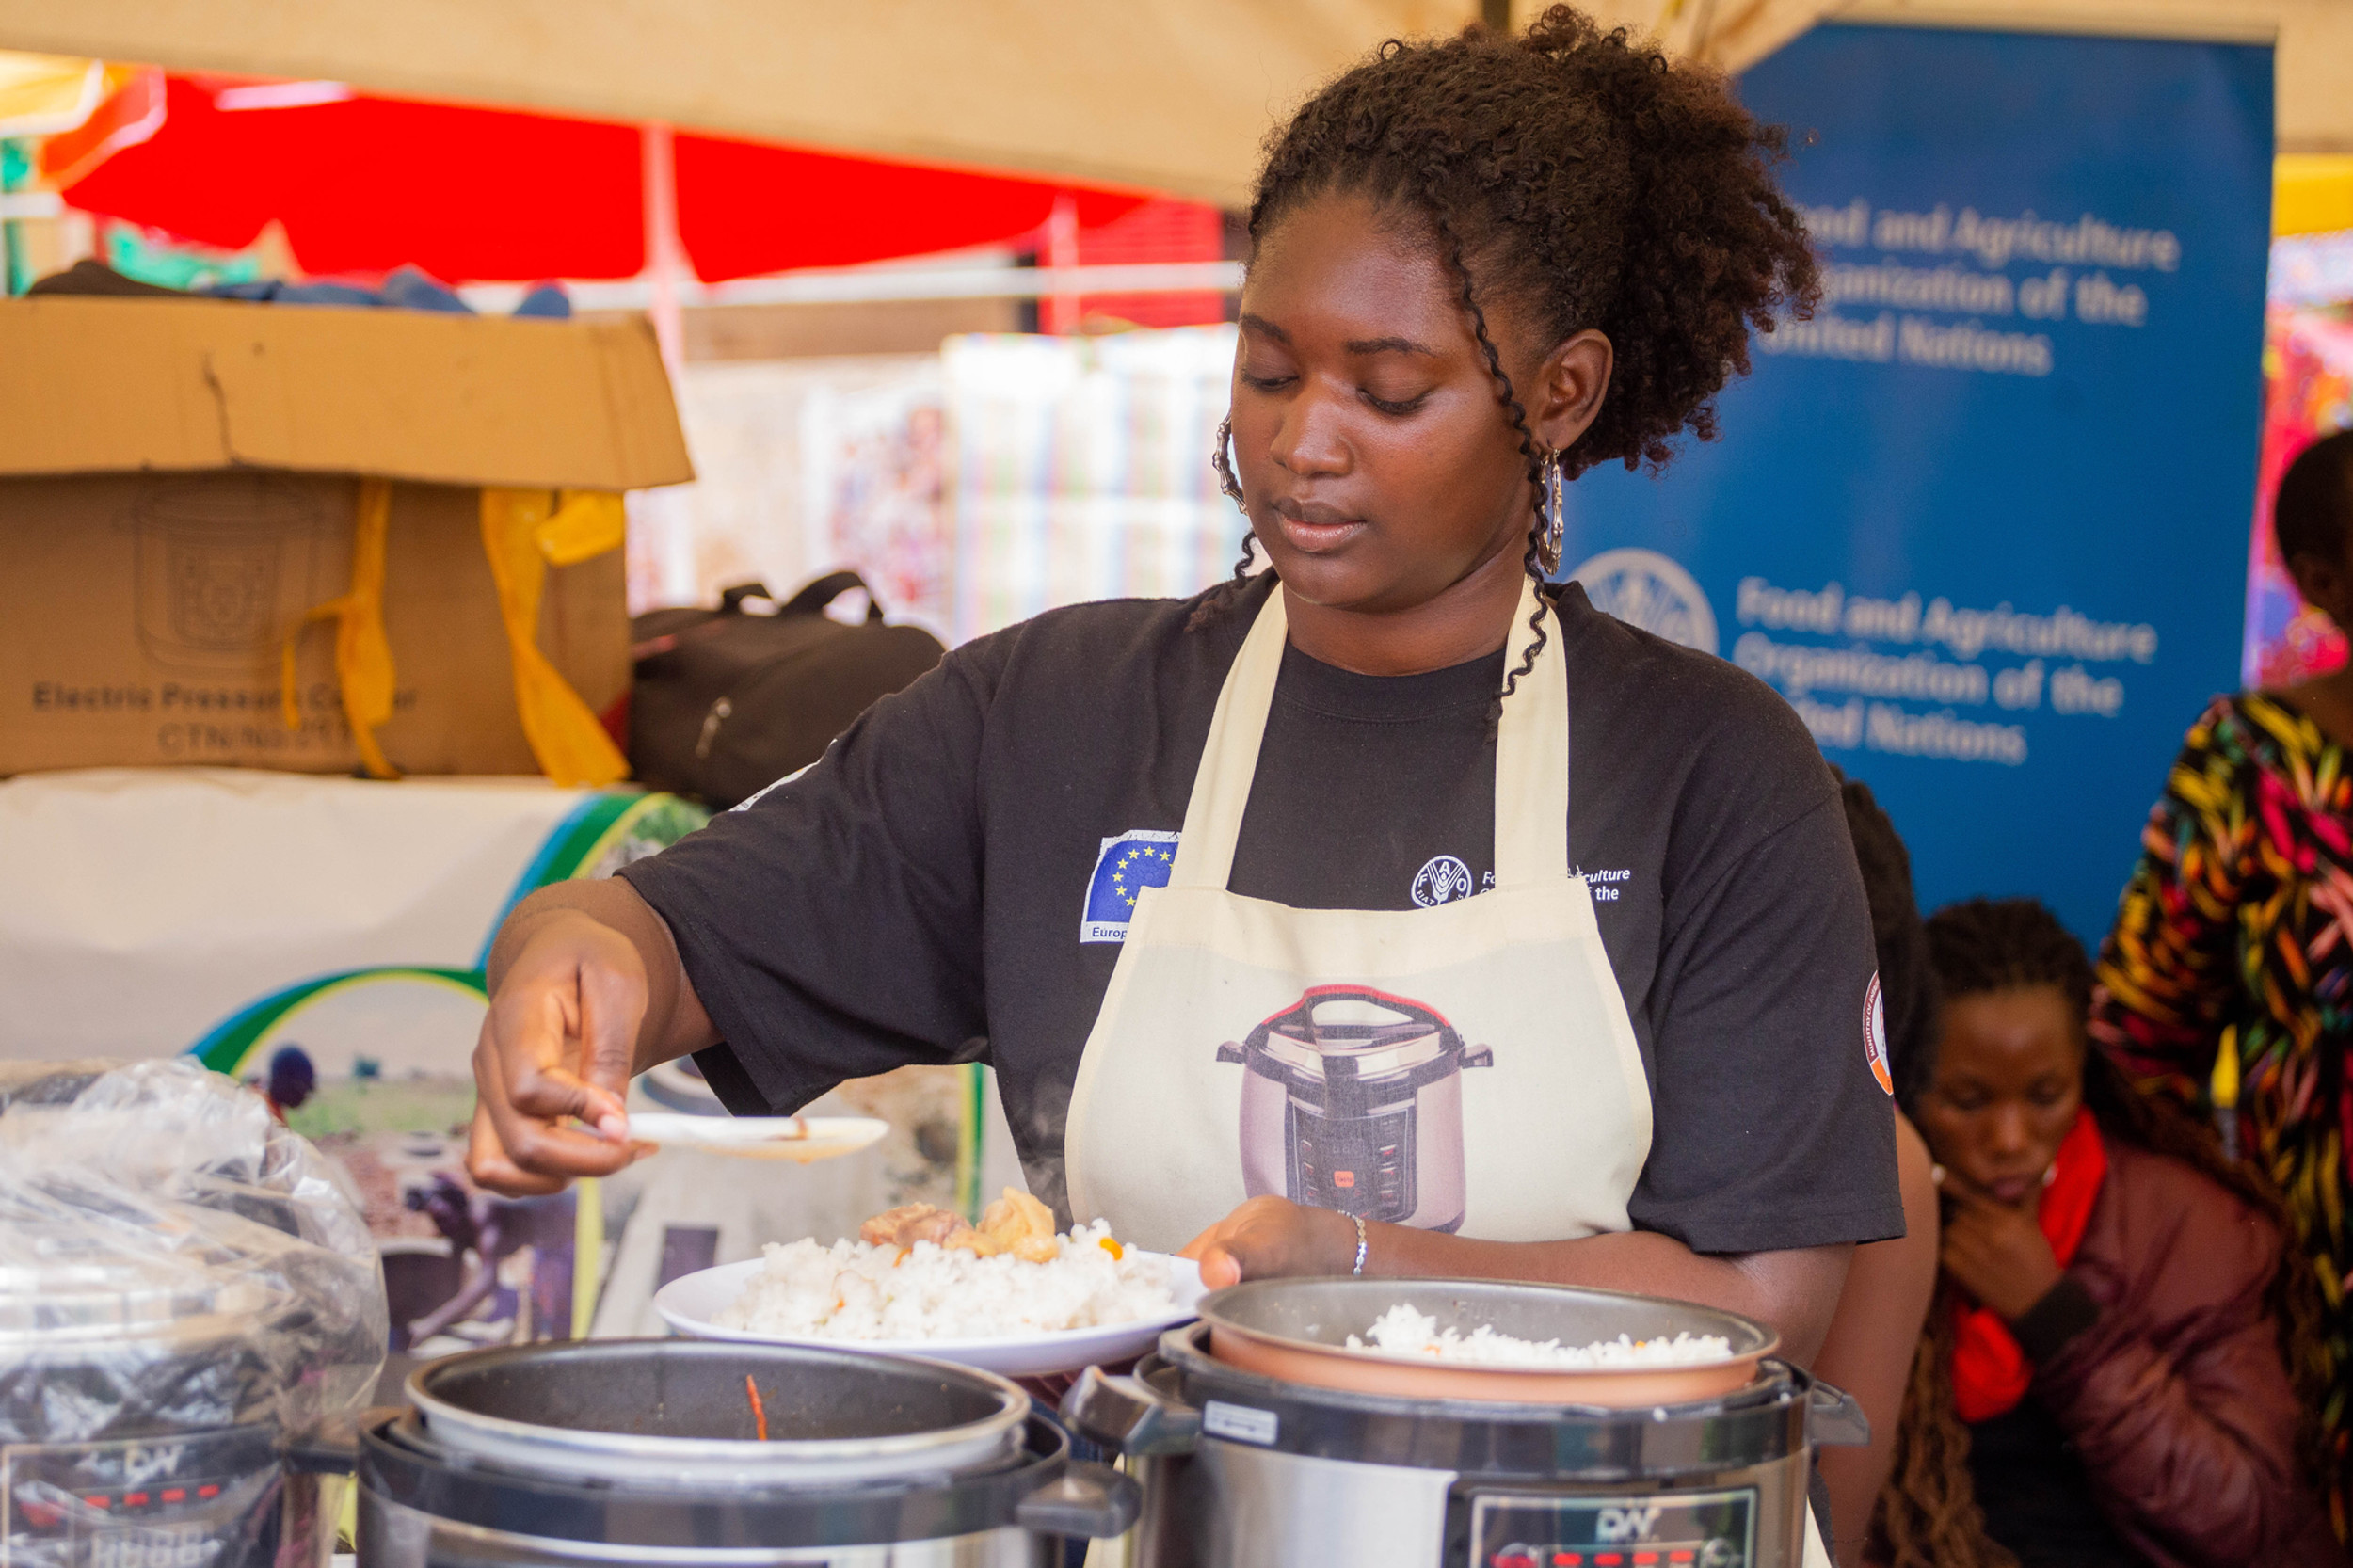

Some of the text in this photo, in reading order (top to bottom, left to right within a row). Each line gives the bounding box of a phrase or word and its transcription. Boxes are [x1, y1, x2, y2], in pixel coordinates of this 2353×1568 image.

[1873, 201, 1952, 253] and
[1954, 205, 2181, 272] Agriculture
[2018, 267, 2067, 320] of
[2076, 269, 2148, 327] the
[1898, 313, 2053, 376] Nations
[1737, 576, 1843, 635] Food
[1844, 591, 1922, 644] and
[1923, 597, 2156, 664] Agriculture
[31, 681, 152, 712] Electric
[1733, 632, 2123, 717] Organization of the
[1866, 700, 2026, 765] Nations
[1416, 889, 1436, 906] FIAT
[1595, 885, 1619, 901] the
[1865, 1017, 1876, 1056] MINISTRY
